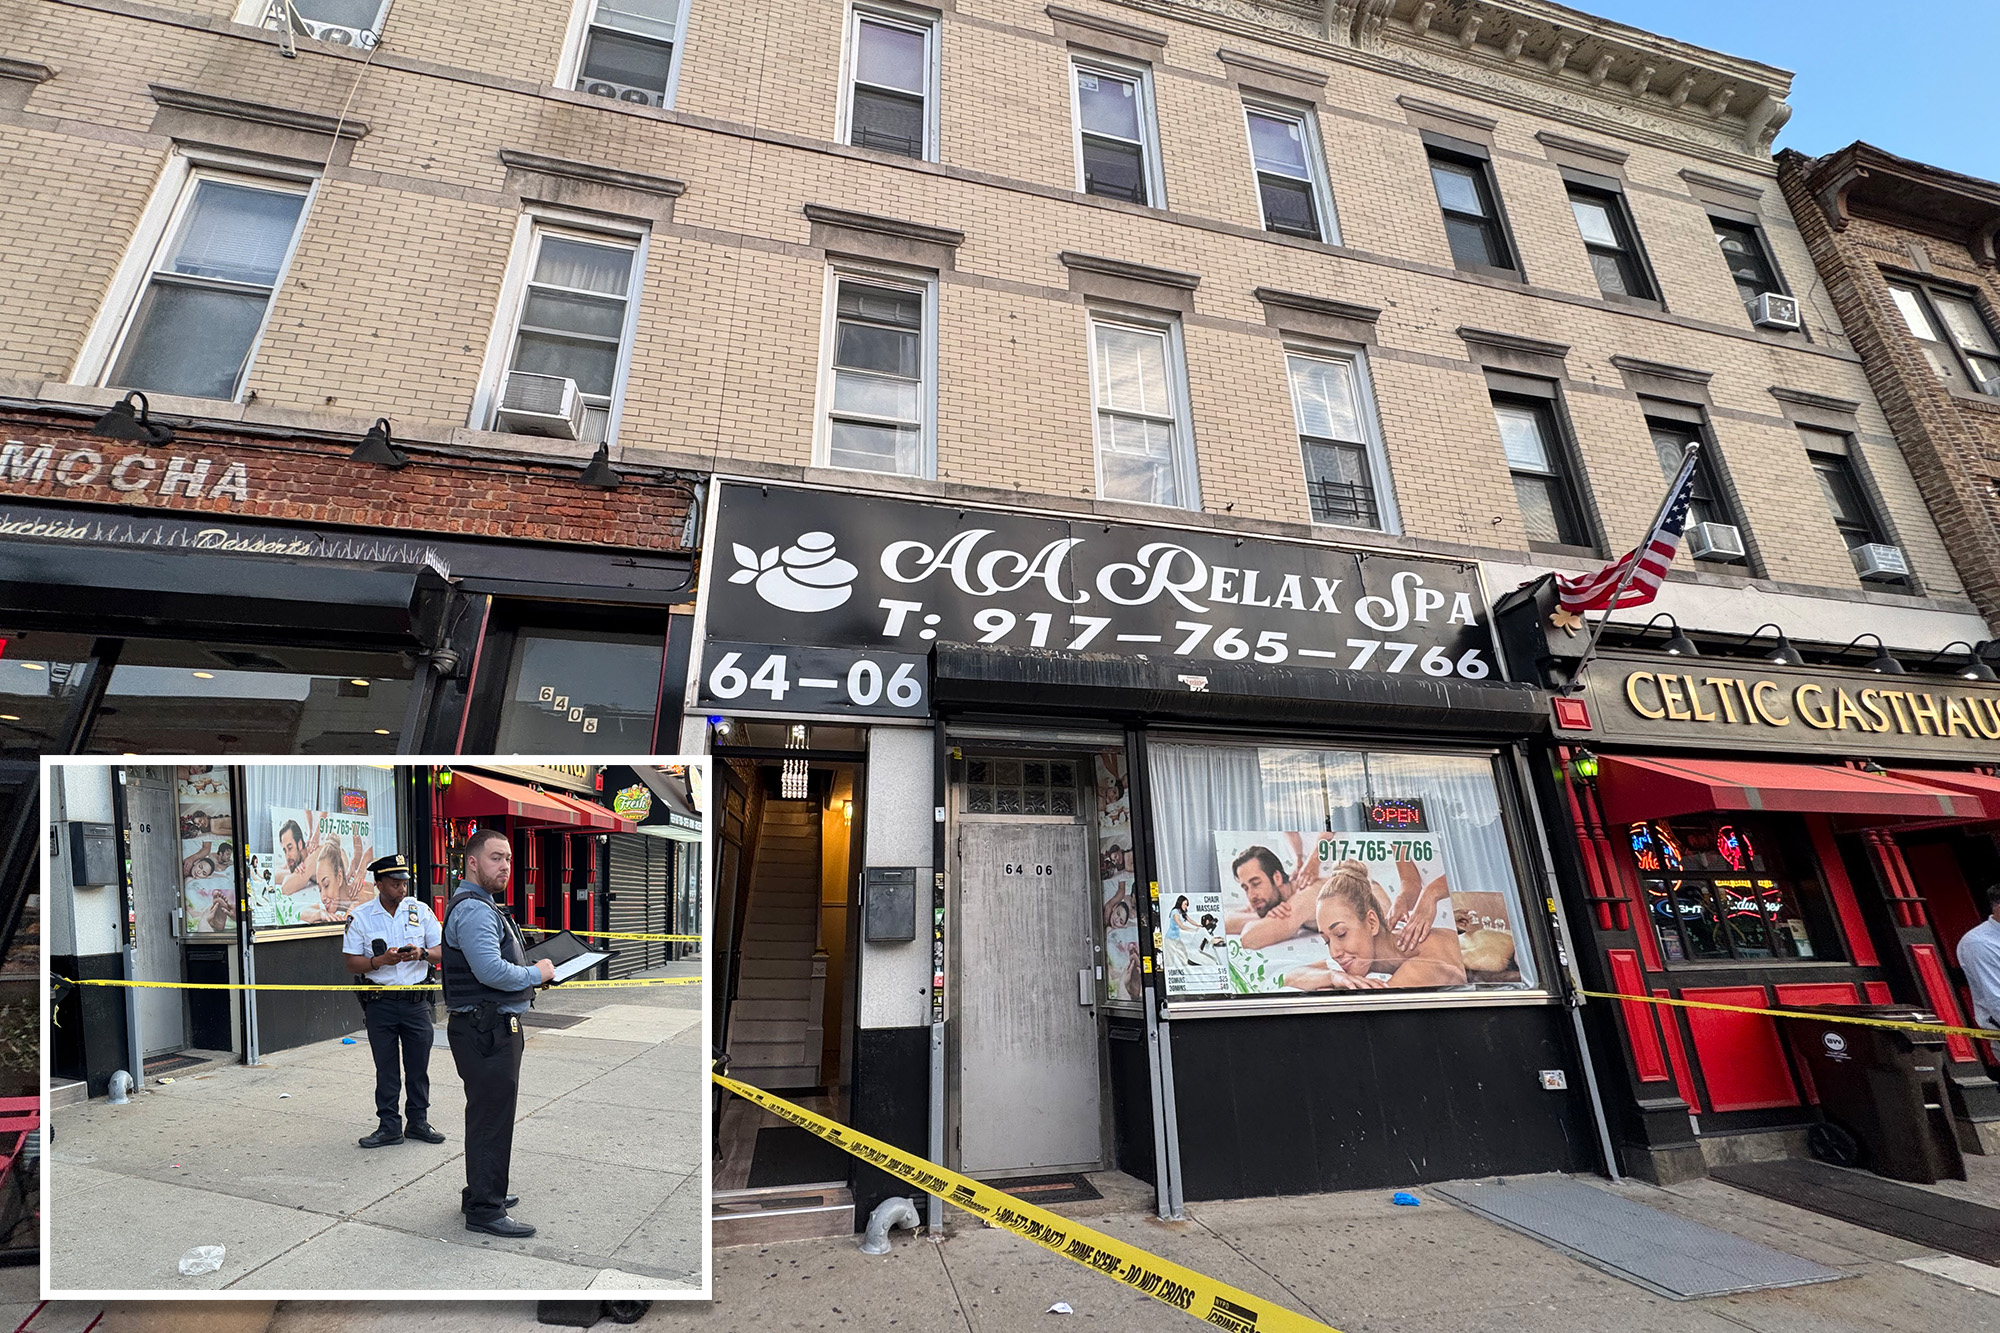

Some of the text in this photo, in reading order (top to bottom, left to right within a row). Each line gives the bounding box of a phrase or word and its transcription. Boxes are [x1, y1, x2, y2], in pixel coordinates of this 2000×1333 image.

[0, 440, 248, 500] MOCHA
[0, 521, 311, 556] uccino Desserts
[880, 529, 1478, 632] AA RELAX SPA
[878, 598, 1490, 680] T: 917-765-7766
[709, 652, 922, 708] 64-06
[1626, 671, 2000, 740] CELTIC GASTHAU
[343, 795, 366, 809] OPEN
[619, 796, 646, 810] Fresh
[1372, 807, 1420, 824] OPEN
[140, 824, 151, 833] 06
[319, 818, 369, 836] 917-765-7766
[1319, 840, 1433, 862] 917-765-7766
[1196, 904, 1220, 913] MASSAGE
[1203, 896, 1220, 904] CHAIR
[1063, 1239, 1095, 1262] CRIME
[1087, 1249, 1122, 1275] SCENE
[1121, 1264, 1142, 1284] DO
[1135, 1270, 1163, 1294] NOT
[1155, 1279, 1196, 1310] CROSS
[1216, 1298, 1230, 1310] NYPD
